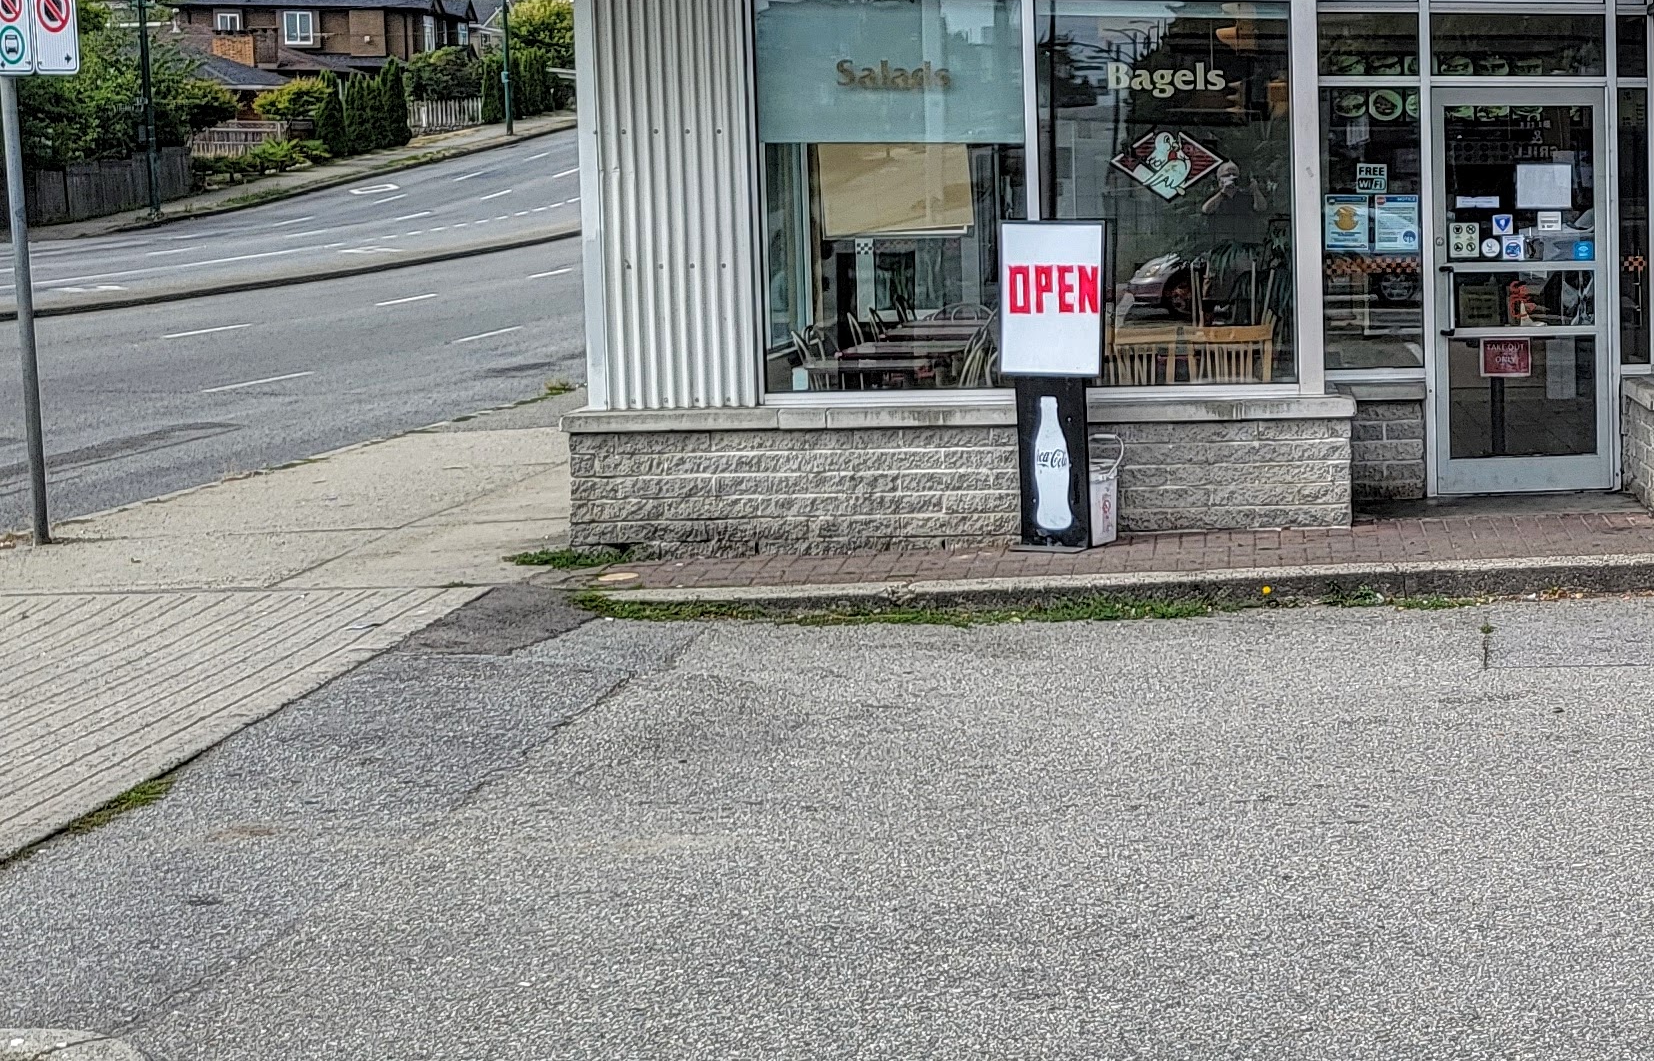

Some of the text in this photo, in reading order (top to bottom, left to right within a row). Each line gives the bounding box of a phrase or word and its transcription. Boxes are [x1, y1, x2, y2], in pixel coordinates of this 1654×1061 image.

[836, 59, 951, 90] Salads
[1106, 61, 1226, 98] Bagels
[1358, 166, 1385, 176] FREE
[1008, 264, 1099, 315] OPEN
[1486, 343, 1525, 352] TAKE OUT
[1495, 355, 1515, 363] ONLY
